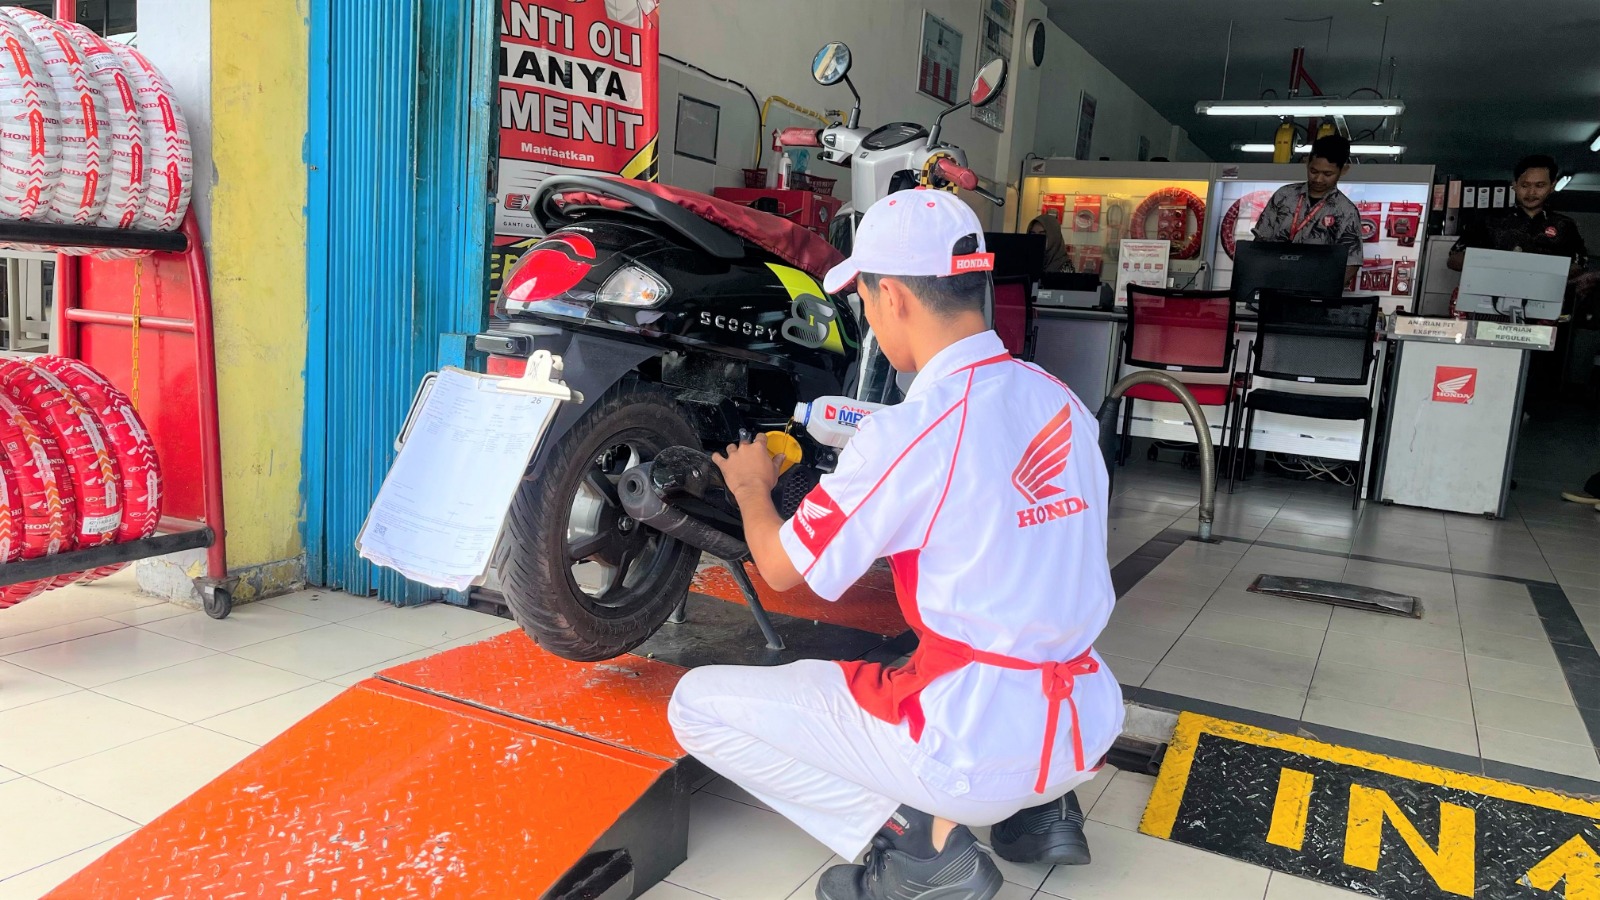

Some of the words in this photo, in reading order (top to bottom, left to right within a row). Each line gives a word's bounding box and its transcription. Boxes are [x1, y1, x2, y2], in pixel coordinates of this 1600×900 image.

[588, 21, 642, 67] OLI
[501, 88, 644, 150] MENIT
[521, 142, 595, 163] Manfaatkan
[956, 258, 991, 269] HONDA
[700, 311, 778, 341] SCOOPY
[1497, 325, 1532, 333] ANTRIAN
[1436, 391, 1472, 399] HONDA
[1266, 768, 1476, 900] IN
